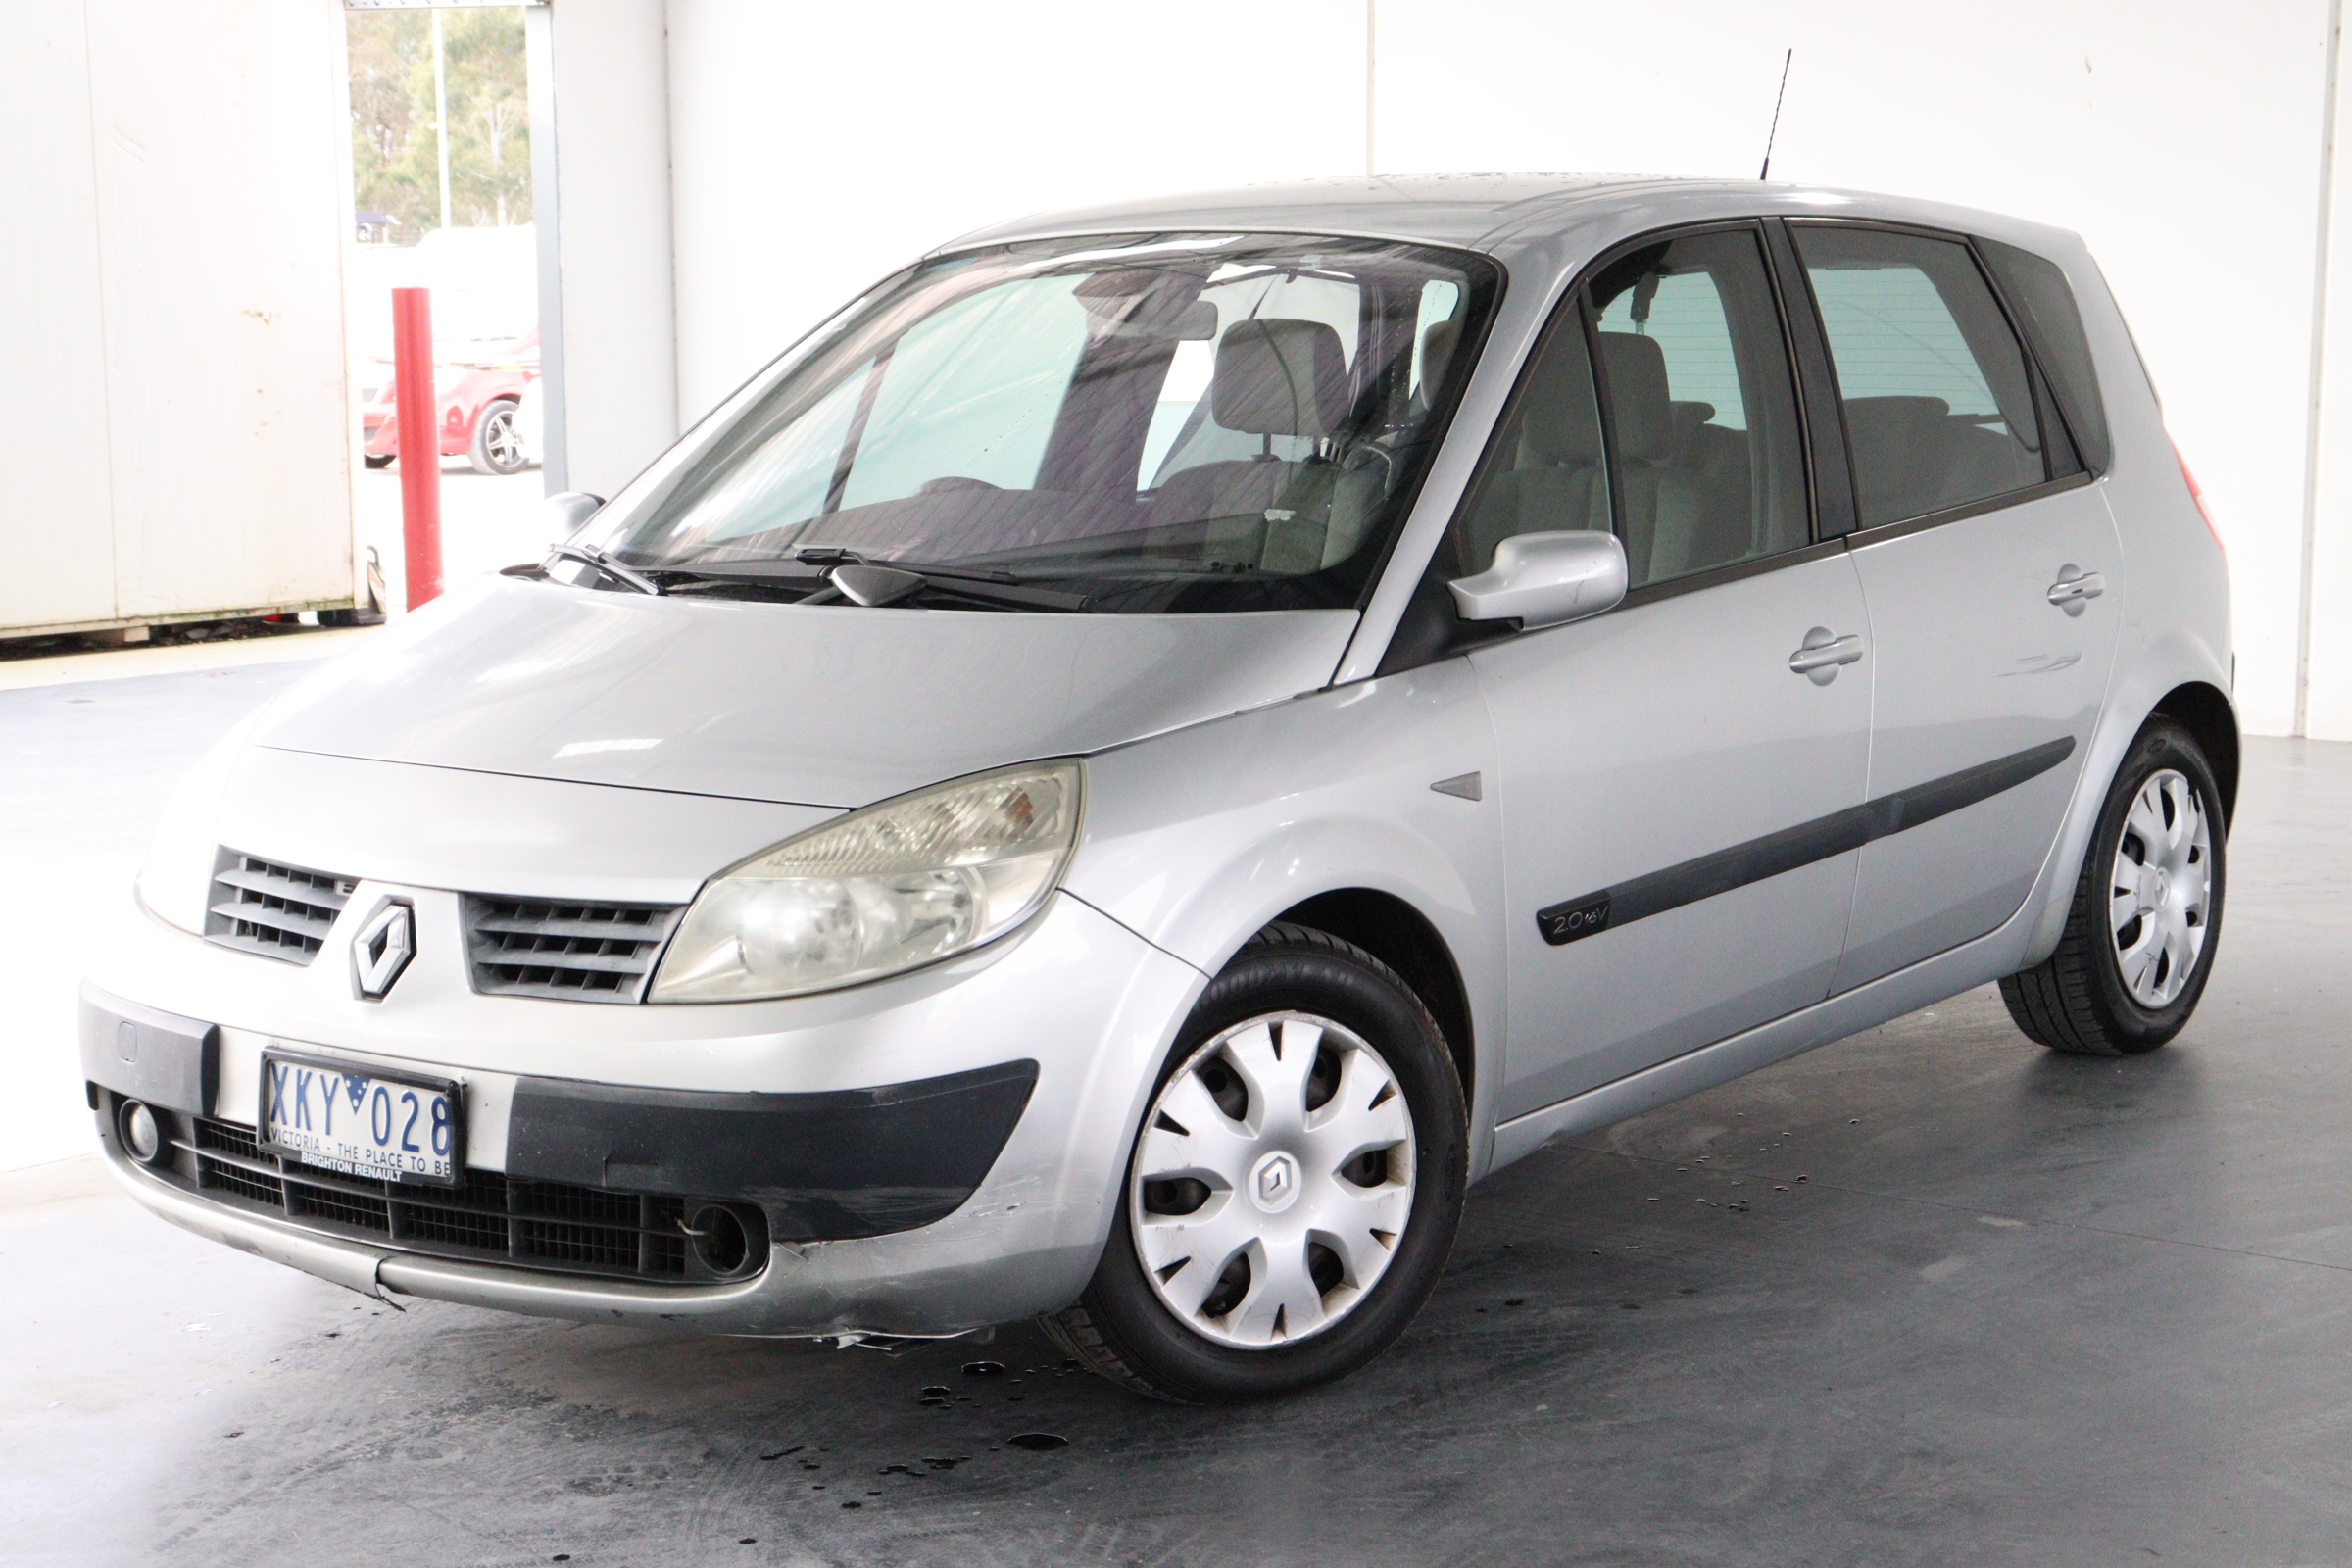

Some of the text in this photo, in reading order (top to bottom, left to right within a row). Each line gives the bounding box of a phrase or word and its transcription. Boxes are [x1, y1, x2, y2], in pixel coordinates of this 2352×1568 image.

[1553, 906, 1608, 934] 2.0 16V
[270, 1062, 451, 1156] XKY 028
[270, 1127, 320, 1152] VICTORIA
[337, 1143, 358, 1159] THE
[366, 1149, 403, 1168] PLACE
[410, 1156, 426, 1172] TO
[435, 1161, 451, 1176] BE
[301, 1152, 402, 1182] BRIGHTON RENAULT
